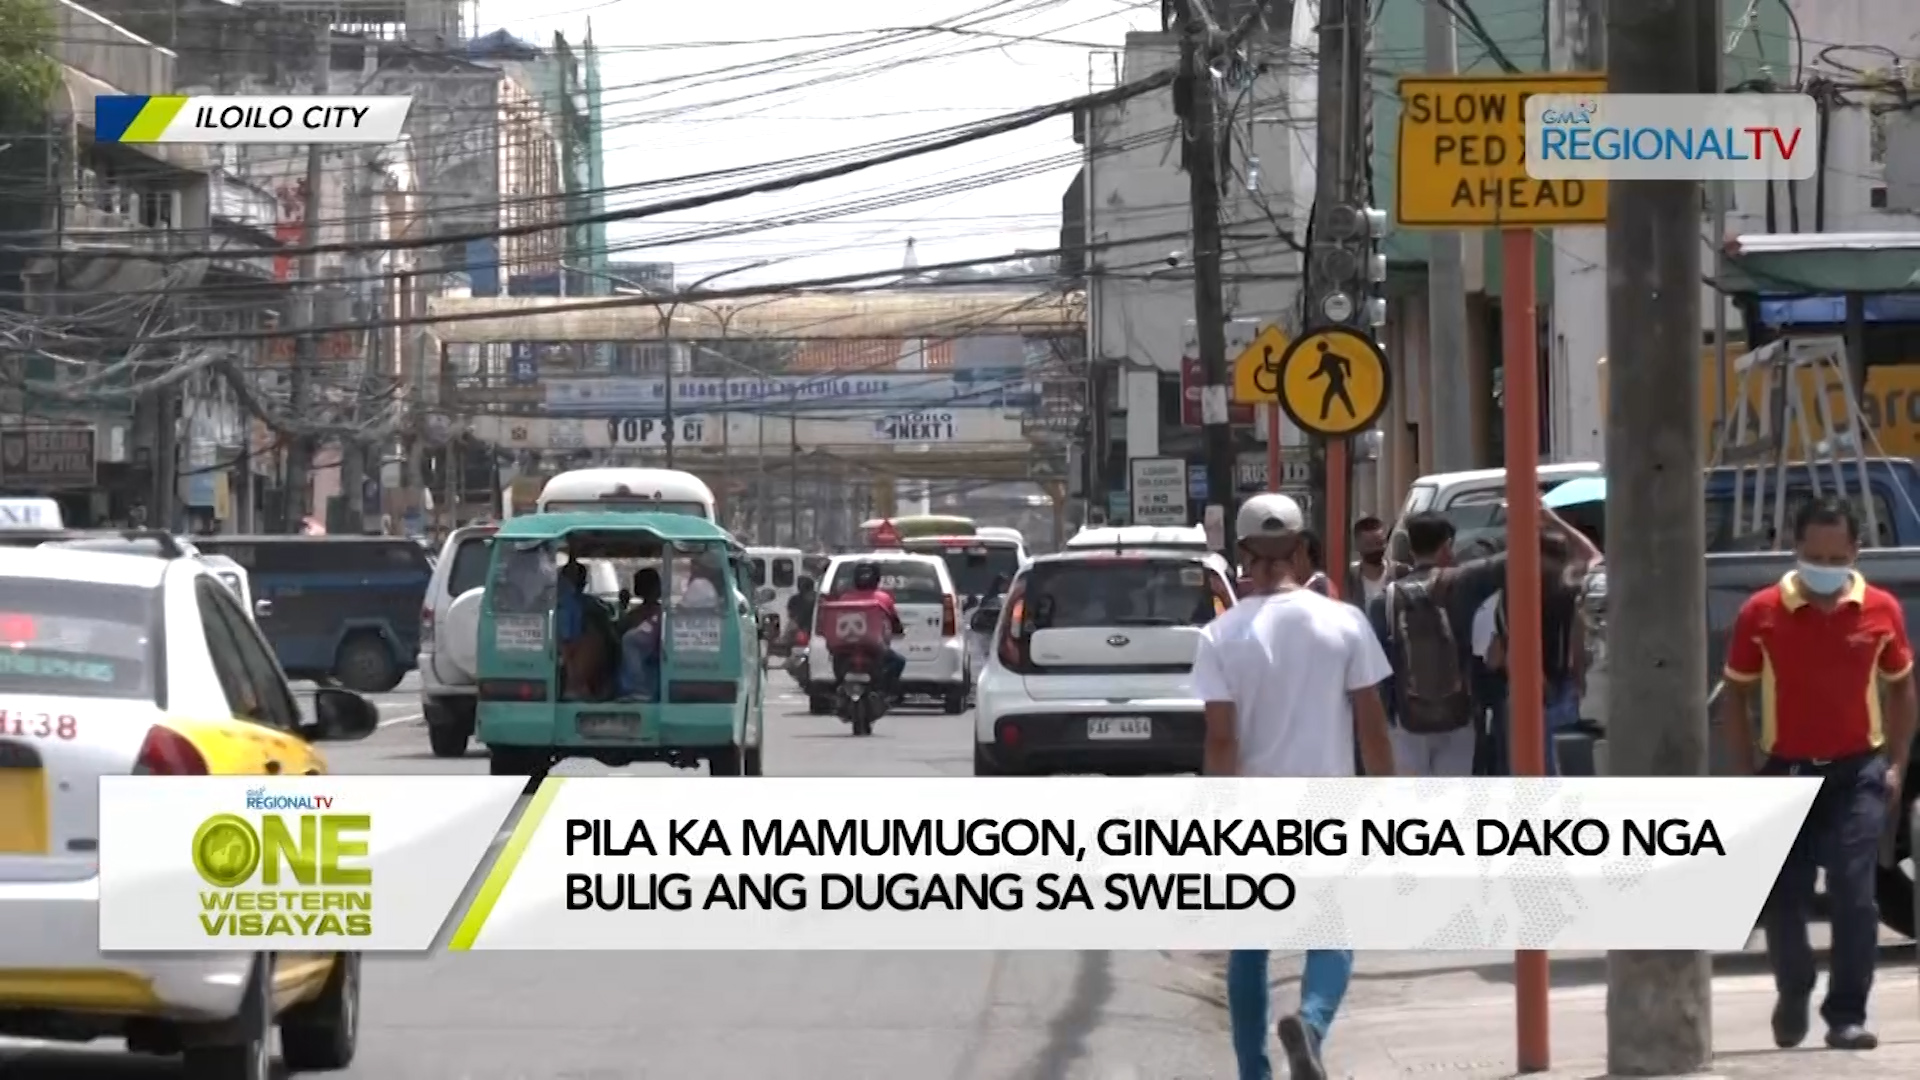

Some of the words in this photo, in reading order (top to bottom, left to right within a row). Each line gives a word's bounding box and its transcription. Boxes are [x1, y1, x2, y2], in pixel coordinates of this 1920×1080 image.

[1409, 93, 1505, 124] SLOW
[1433, 134, 1506, 166] PED
[1450, 177, 1586, 209] AHEAD
